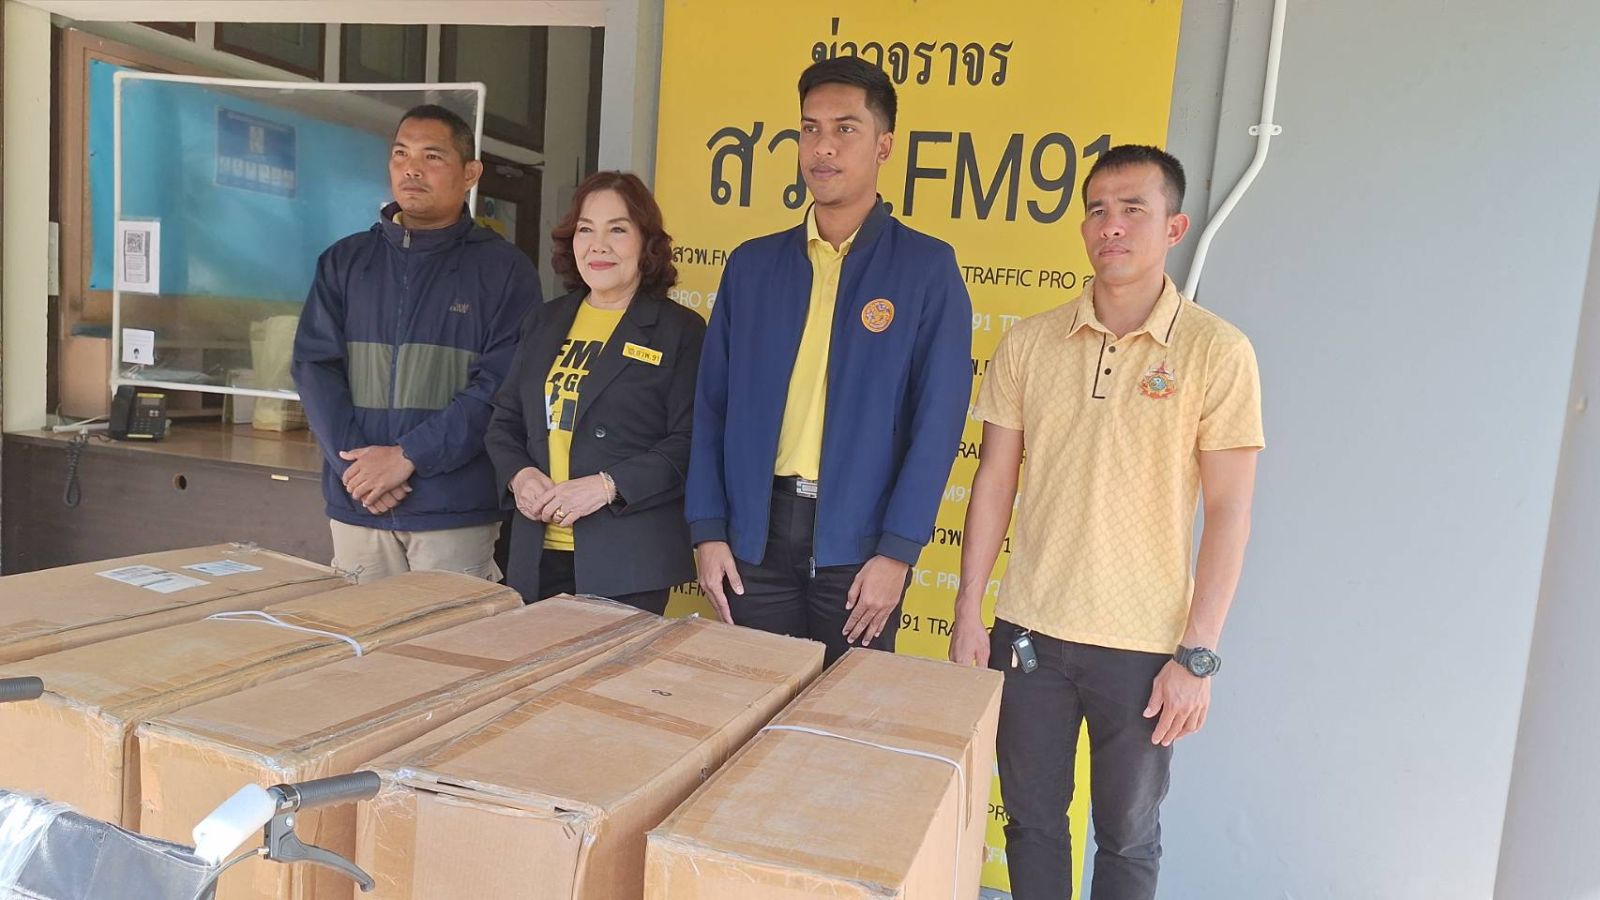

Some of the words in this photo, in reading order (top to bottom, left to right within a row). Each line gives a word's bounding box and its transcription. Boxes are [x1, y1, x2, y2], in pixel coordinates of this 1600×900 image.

[962, 265, 1033, 287] TRAFFIC
[1038, 270, 1076, 289] PRO
[936, 571, 960, 591] PR
